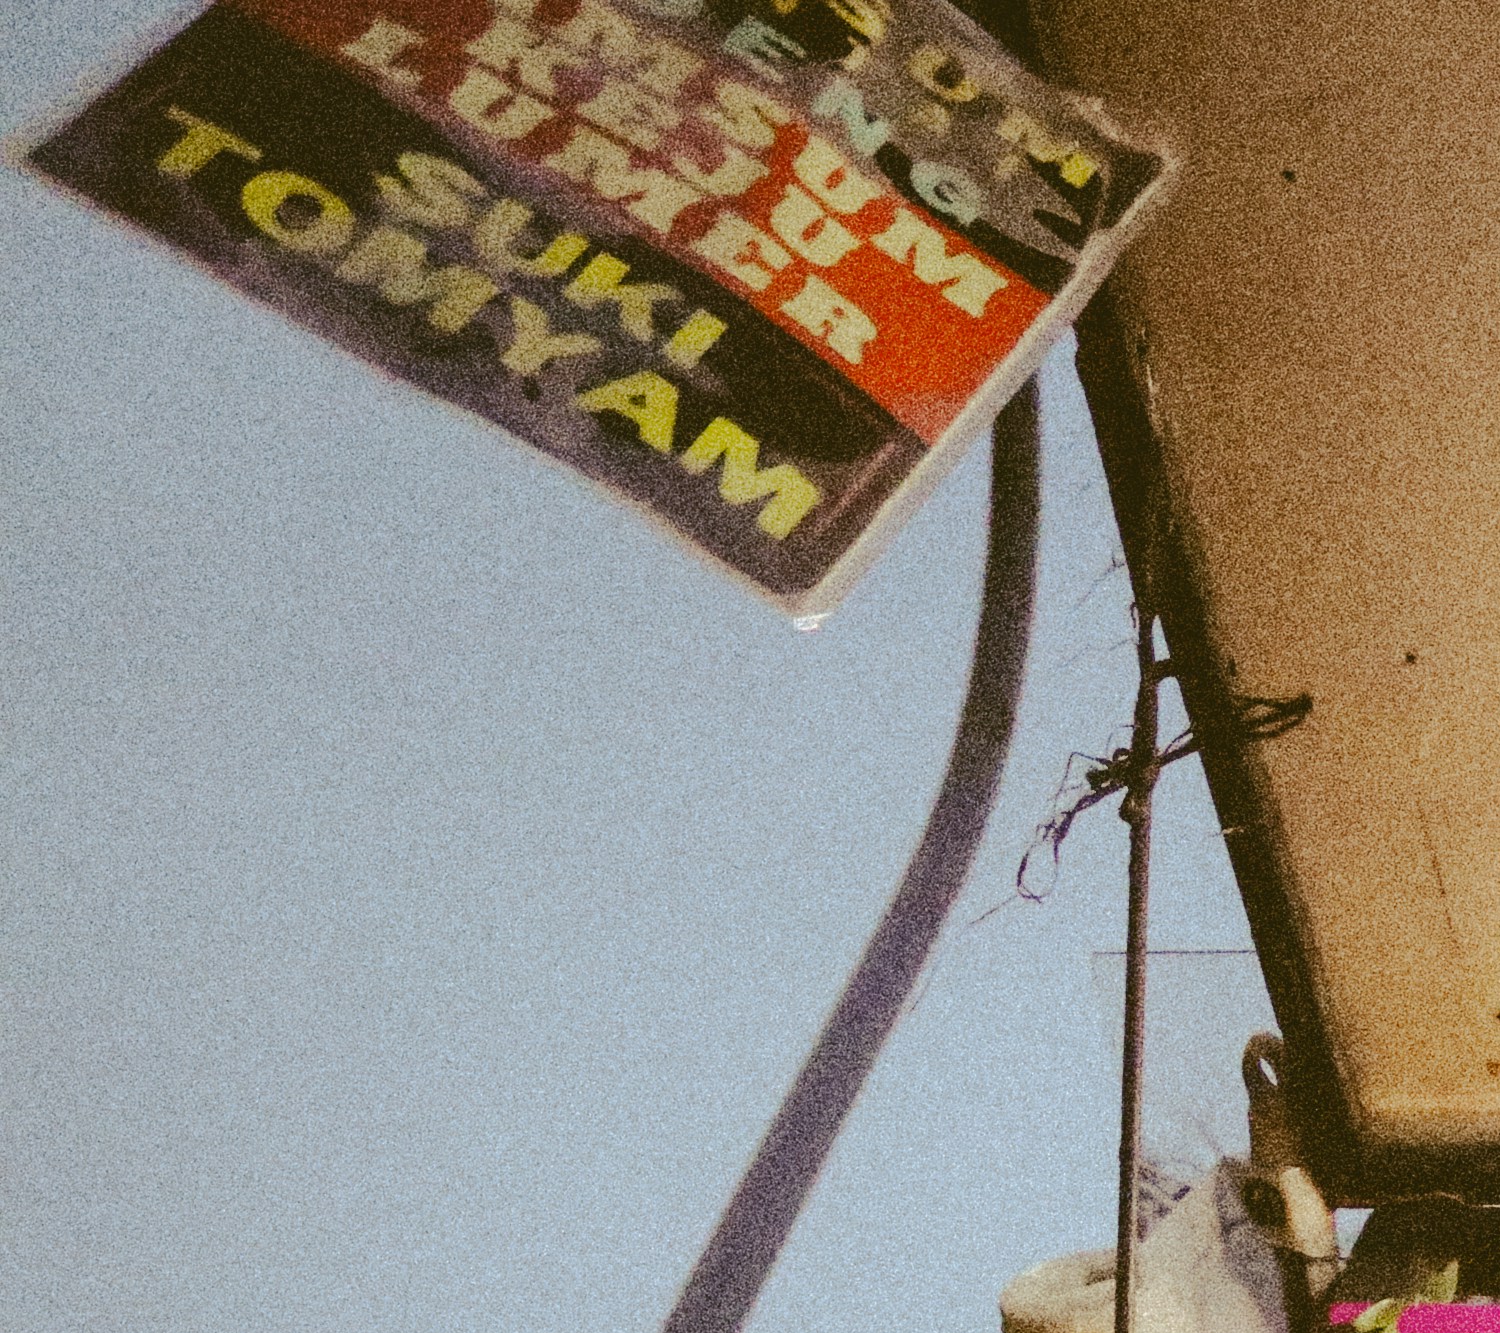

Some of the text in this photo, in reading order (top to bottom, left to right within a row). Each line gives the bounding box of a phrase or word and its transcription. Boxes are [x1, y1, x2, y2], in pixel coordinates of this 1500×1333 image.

[342, 15, 878, 366] LUMER
[374, 151, 728, 368] SUKI
[462, 2, 862, 268] KEJU
[156, 104, 823, 541] TOMYAM
